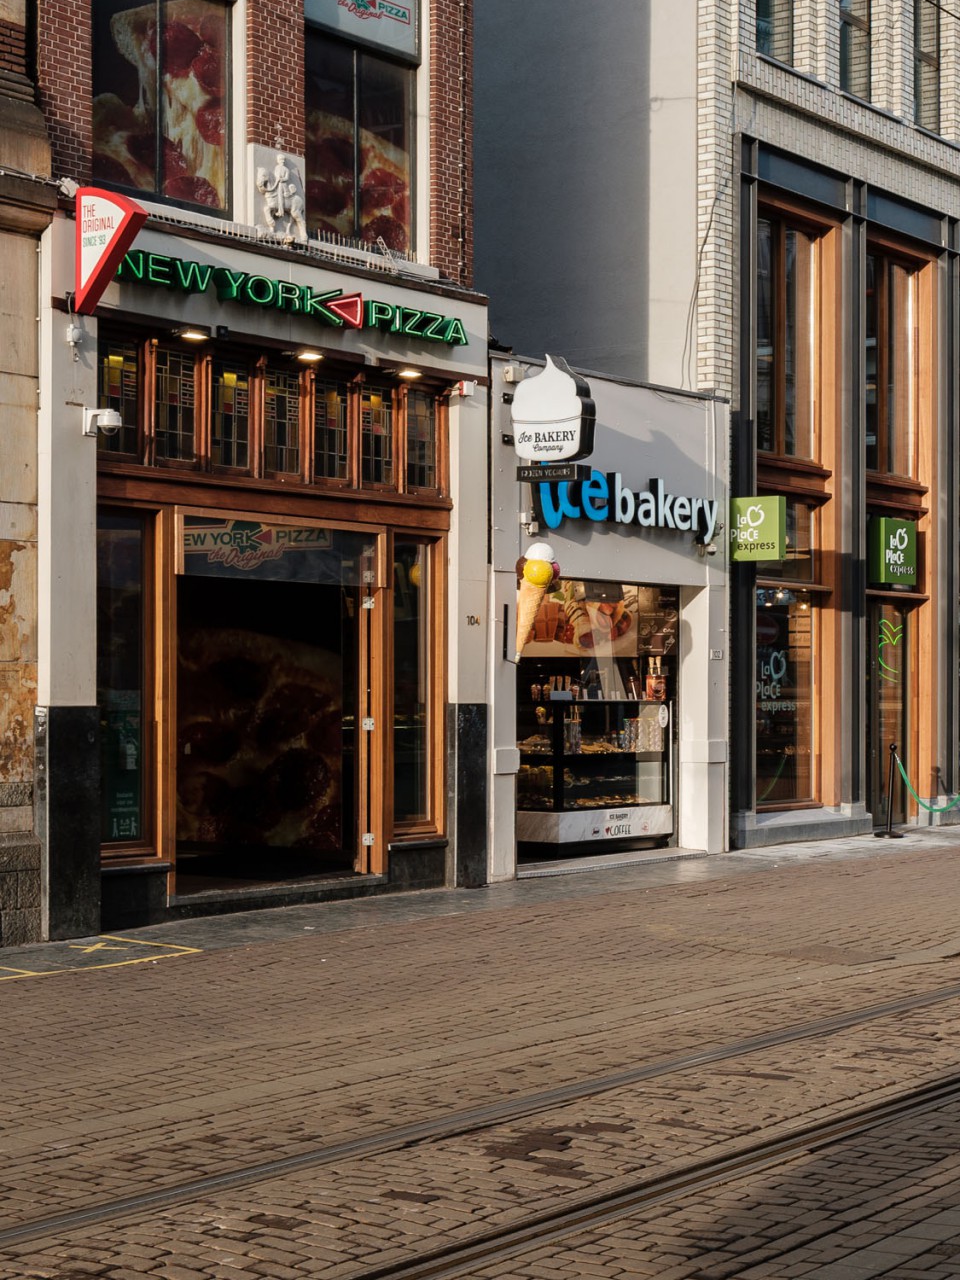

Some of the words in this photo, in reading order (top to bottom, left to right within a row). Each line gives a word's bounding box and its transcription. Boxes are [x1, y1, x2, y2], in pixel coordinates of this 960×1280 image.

[348, 2, 384, 20] Original
[378, 2, 408, 20] PIZZA
[83, 204, 96, 218] THE
[83, 216, 115, 233] ORIGINAL
[83, 235, 97, 247] SINCE
[118, 251, 214, 293] NEW
[215, 269, 344, 326] YORK
[368, 300, 470, 347] PIZZA
[534, 430, 576, 443] BAKERY
[533, 443, 563, 453] Company
[615, 472, 718, 545] bakery
[184, 533, 207, 547] EW
[210, 527, 263, 548] YORK
[276, 528, 328, 543] PIZZA
[737, 541, 776, 554] express
[208, 547, 226, 561] the
[225, 543, 285, 569] Original
[890, 564, 914, 577] express
[466, 615, 480, 626] 104
[761, 700, 796, 715] express
[610, 824, 632, 837] COFFEE
